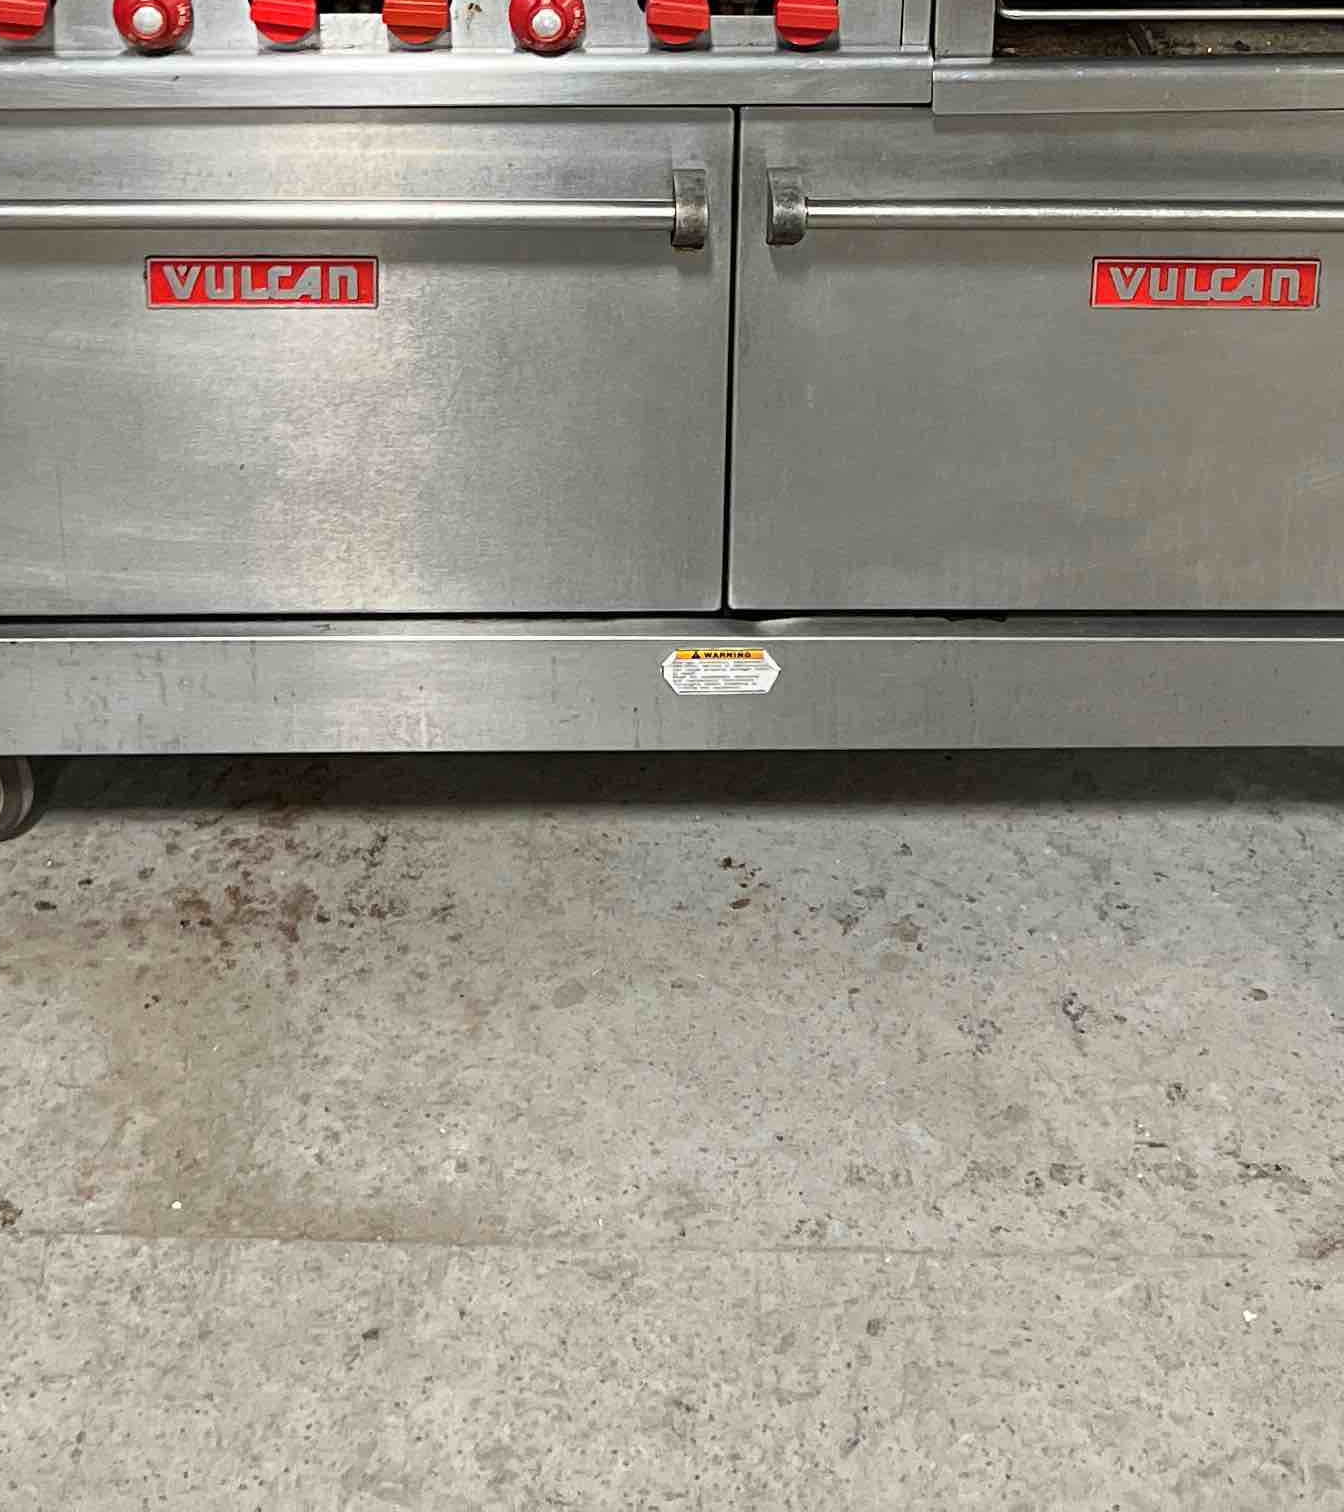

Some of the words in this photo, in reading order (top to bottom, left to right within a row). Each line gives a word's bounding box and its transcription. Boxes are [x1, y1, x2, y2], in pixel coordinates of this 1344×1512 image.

[161, 264, 359, 300] VULCAN
[1108, 266, 1301, 302] VULCAN
[703, 651, 752, 659] WARNING
